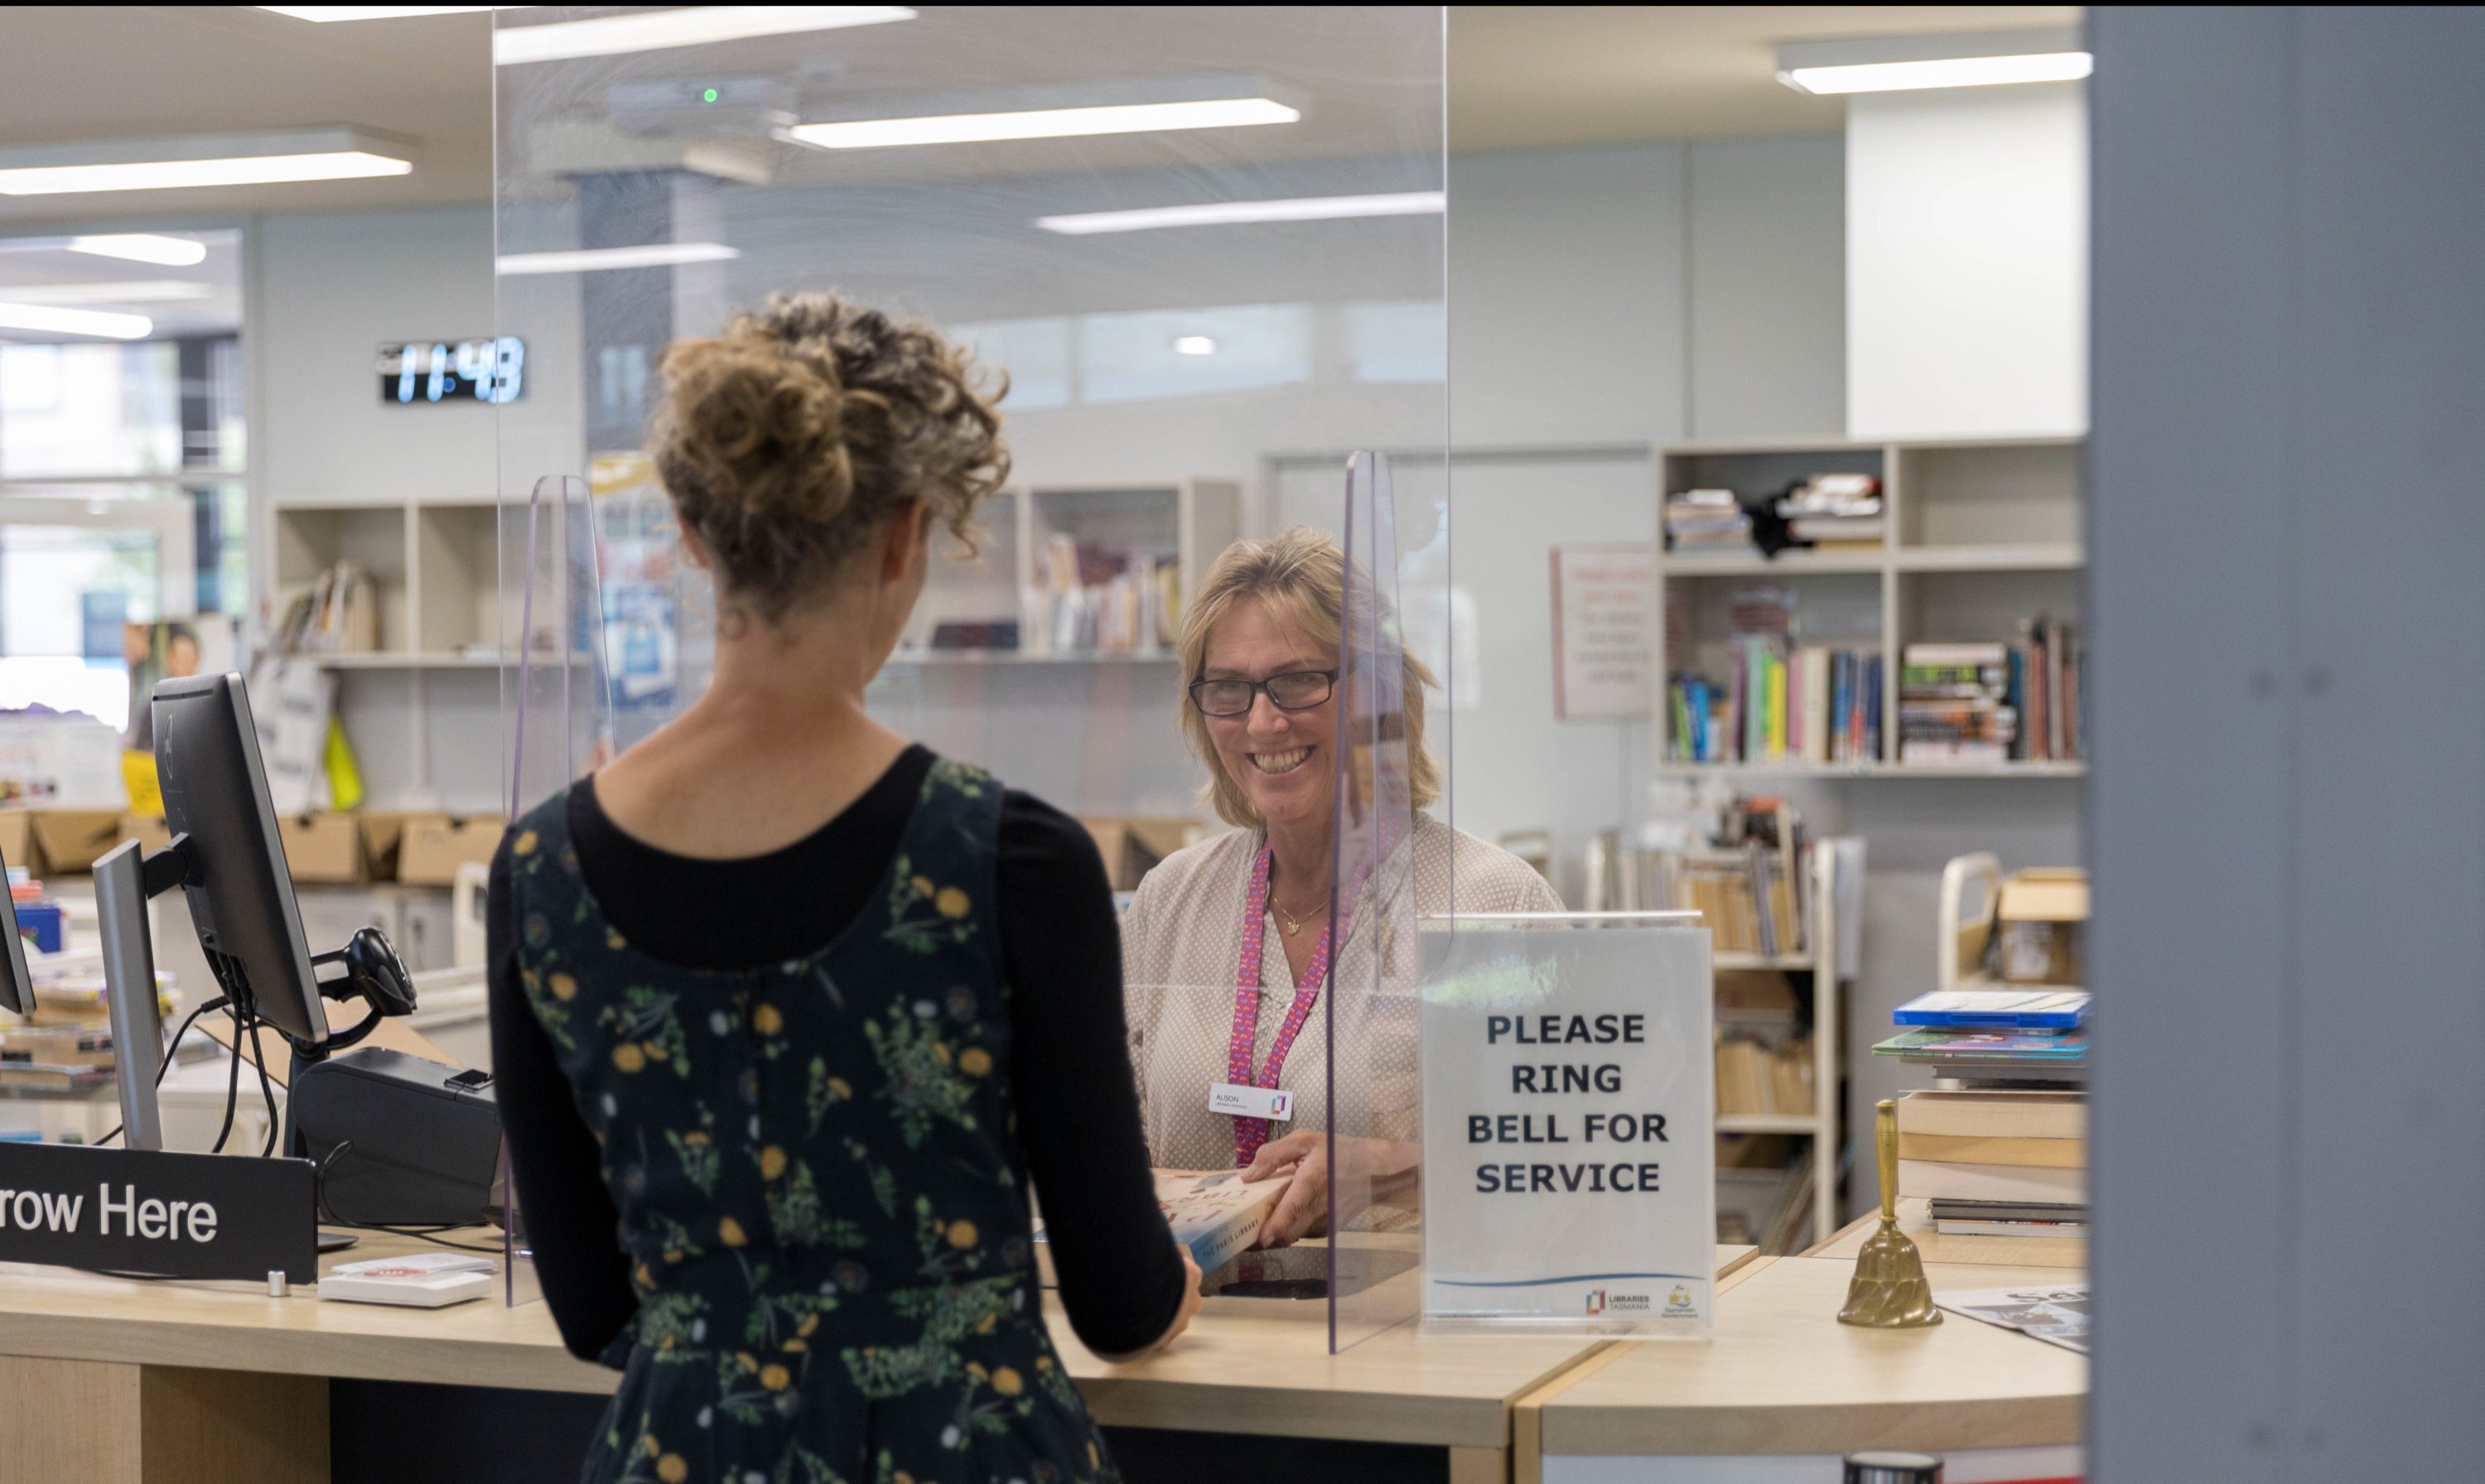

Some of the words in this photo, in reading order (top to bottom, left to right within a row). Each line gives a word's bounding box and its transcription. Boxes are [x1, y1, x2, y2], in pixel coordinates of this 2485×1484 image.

[1487, 1014, 1645, 1044] PLEASE
[1512, 1063, 1622, 1094] RING
[1216, 1093, 1239, 1103] ALISON
[1468, 1114, 1569, 1144] BELL
[1584, 1113, 1670, 1143] FOR
[1476, 1163, 1660, 1193] SERVICE
[100, 1183, 218, 1242] Here
[1235, 1218, 1259, 1239] LIBRARY
